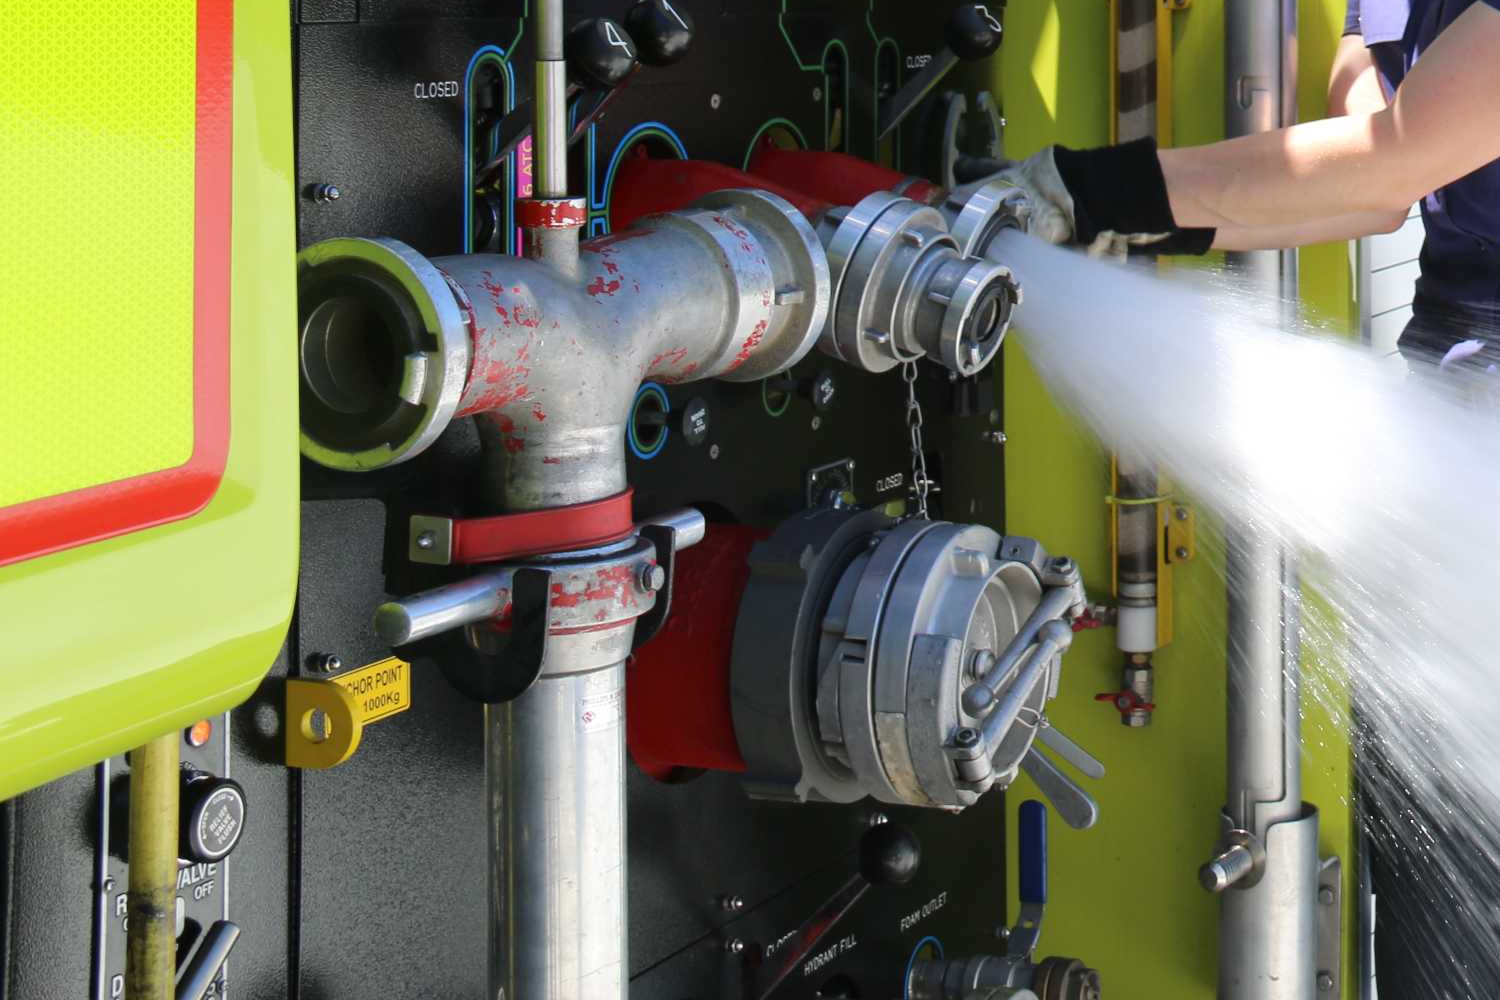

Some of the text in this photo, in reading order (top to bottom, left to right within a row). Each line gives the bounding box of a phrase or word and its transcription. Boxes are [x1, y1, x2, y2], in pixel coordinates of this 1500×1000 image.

[974, 5, 1002, 32] 3
[604, 22, 633, 58] 4
[414, 81, 459, 99] CLOSED
[875, 472, 903, 492] CLOSED
[375, 665, 403, 688] POINT
[363, 691, 400, 713] 1000Kg
[194, 880, 215, 900] OFF
[900, 891, 947, 932] FOAM OUTLET
[803, 933, 858, 976] HYDRANT FILL
